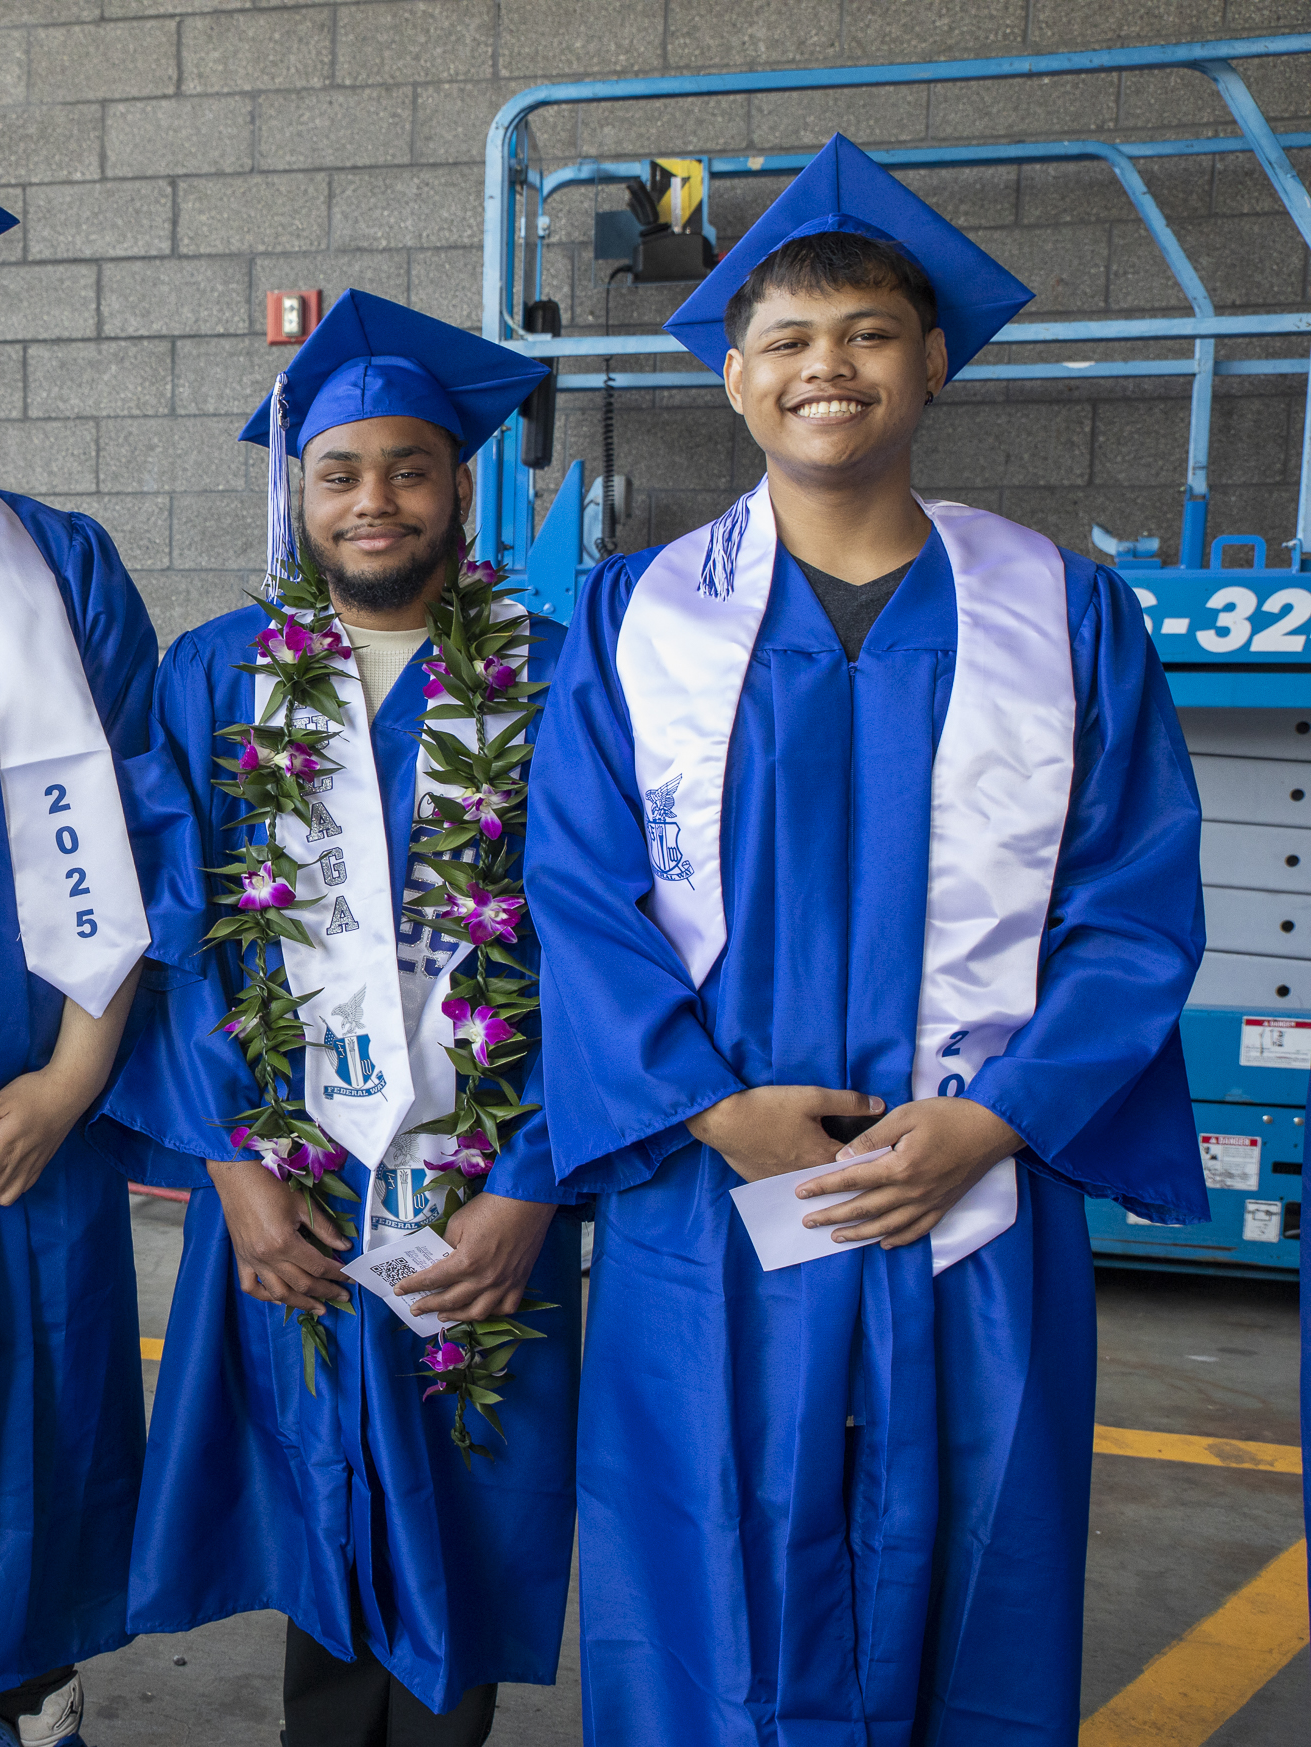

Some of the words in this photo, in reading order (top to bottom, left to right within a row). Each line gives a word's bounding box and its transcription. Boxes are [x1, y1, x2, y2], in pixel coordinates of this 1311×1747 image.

[327, 1086, 368, 1096] FEDERAL
[370, 1079, 386, 1094] WAY
[372, 1217, 418, 1229] FEDERAL
